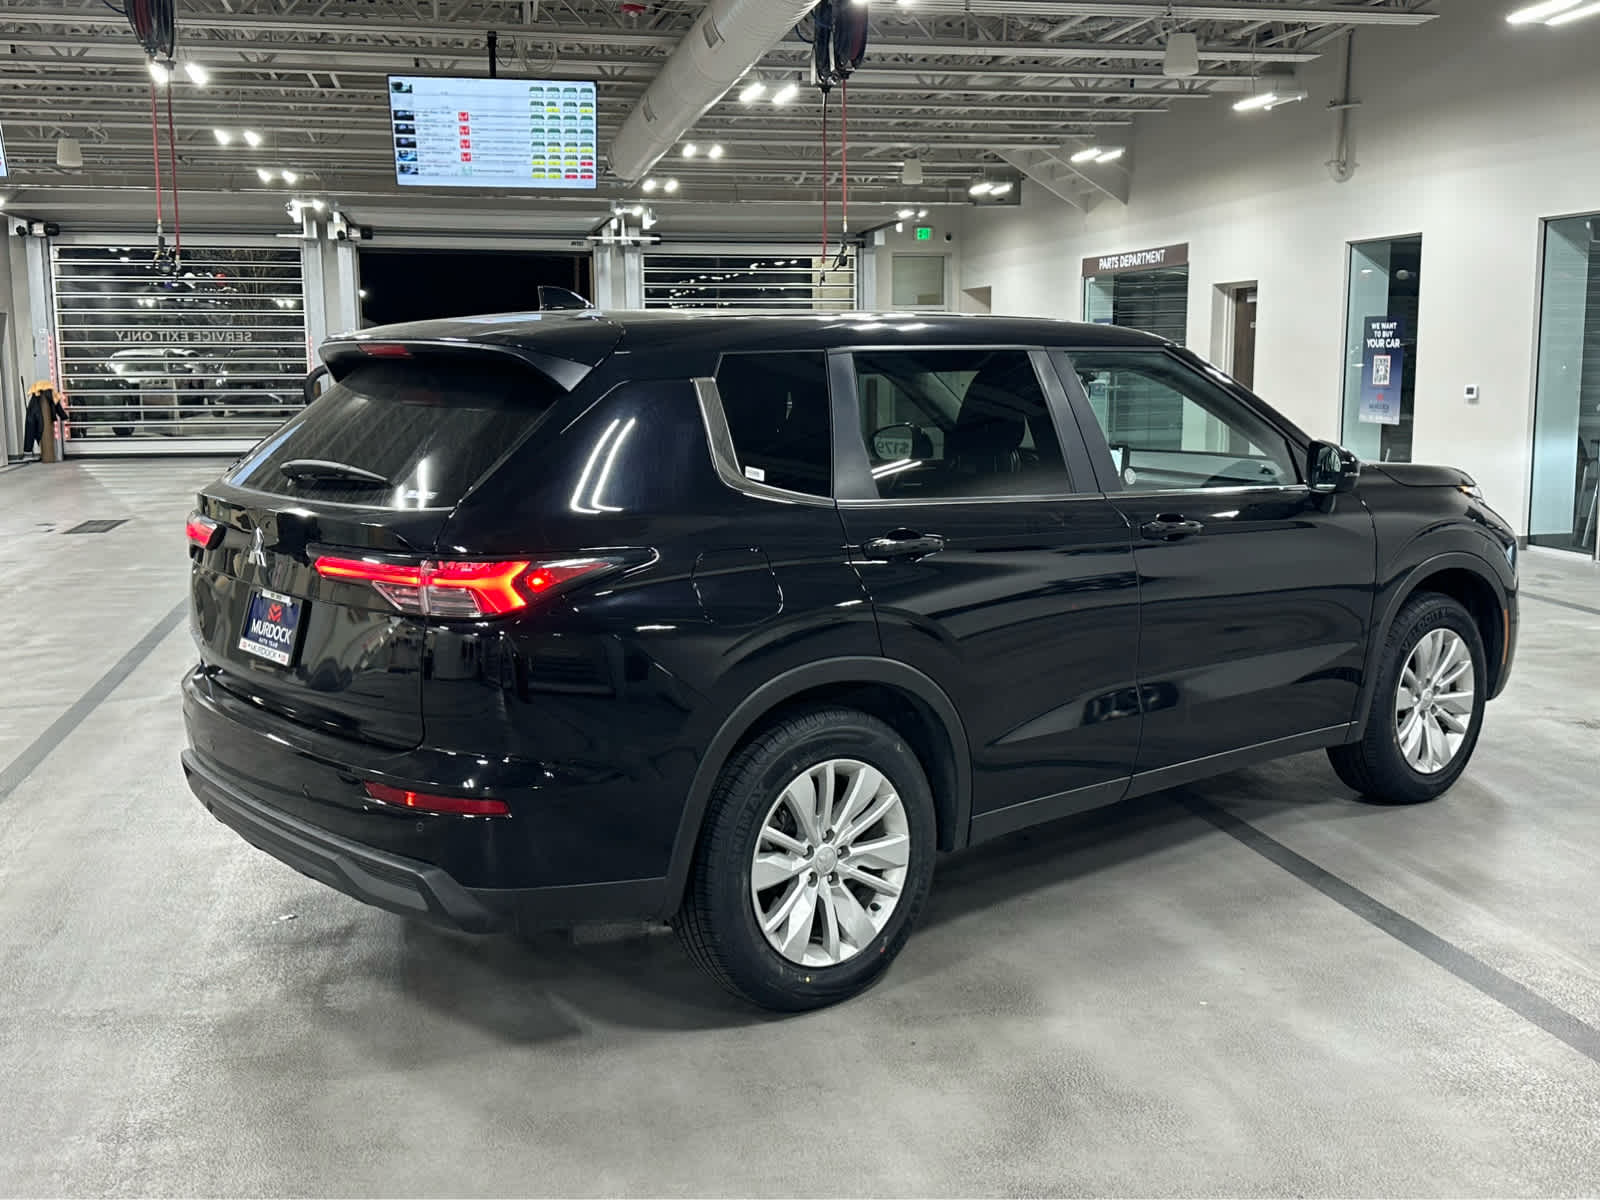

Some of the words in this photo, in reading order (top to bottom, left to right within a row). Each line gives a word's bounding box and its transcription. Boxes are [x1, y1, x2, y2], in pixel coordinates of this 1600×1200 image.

[1099, 256, 1119, 270] PARTS
[1120, 249, 1165, 267] DEPARTMENT
[1383, 330, 1393, 338] BUY
[1367, 339, 1384, 348] YOUR
[1385, 338, 1400, 348] CAR
[251, 618, 292, 645] MURDOCK
